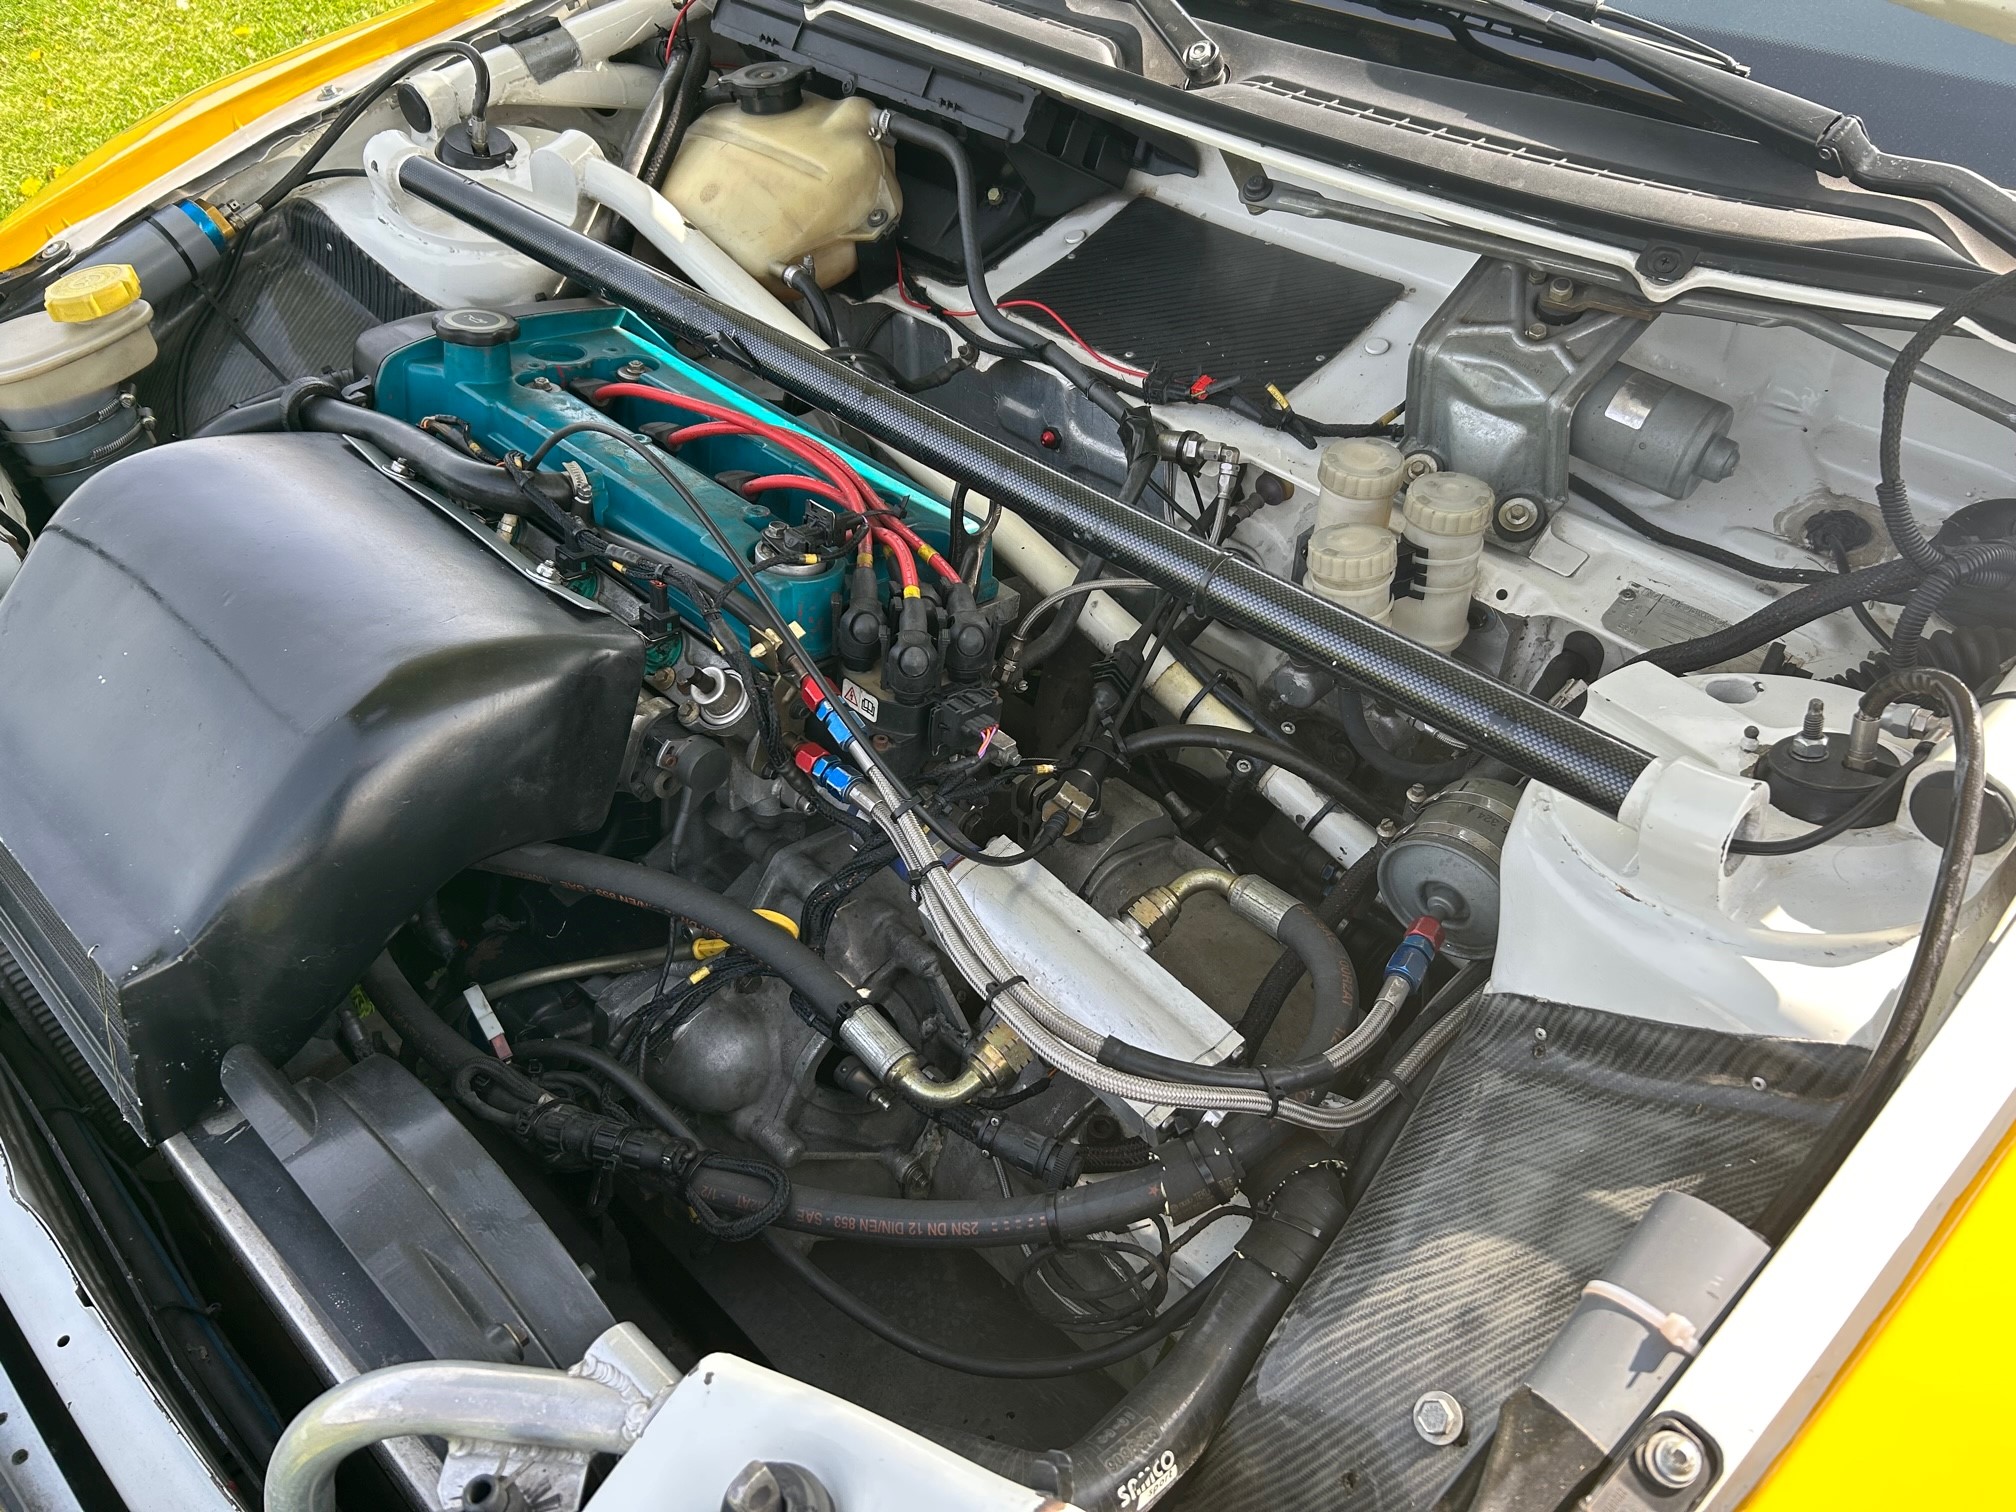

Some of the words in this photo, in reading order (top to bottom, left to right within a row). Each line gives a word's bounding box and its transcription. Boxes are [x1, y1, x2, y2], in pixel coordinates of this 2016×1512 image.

[1476, 812, 1500, 827] 324
[699, 1184, 718, 1203] 1/2
[796, 1208, 824, 1226] SAE
[833, 1214, 856, 1230] 853
[859, 1217, 905, 1236] DIN/EN
[907, 1221, 924, 1236] 12
[927, 1221, 948, 1236] DN
[951, 1220, 979, 1236] 2SN
[1148, 1470, 1173, 1497] sport
